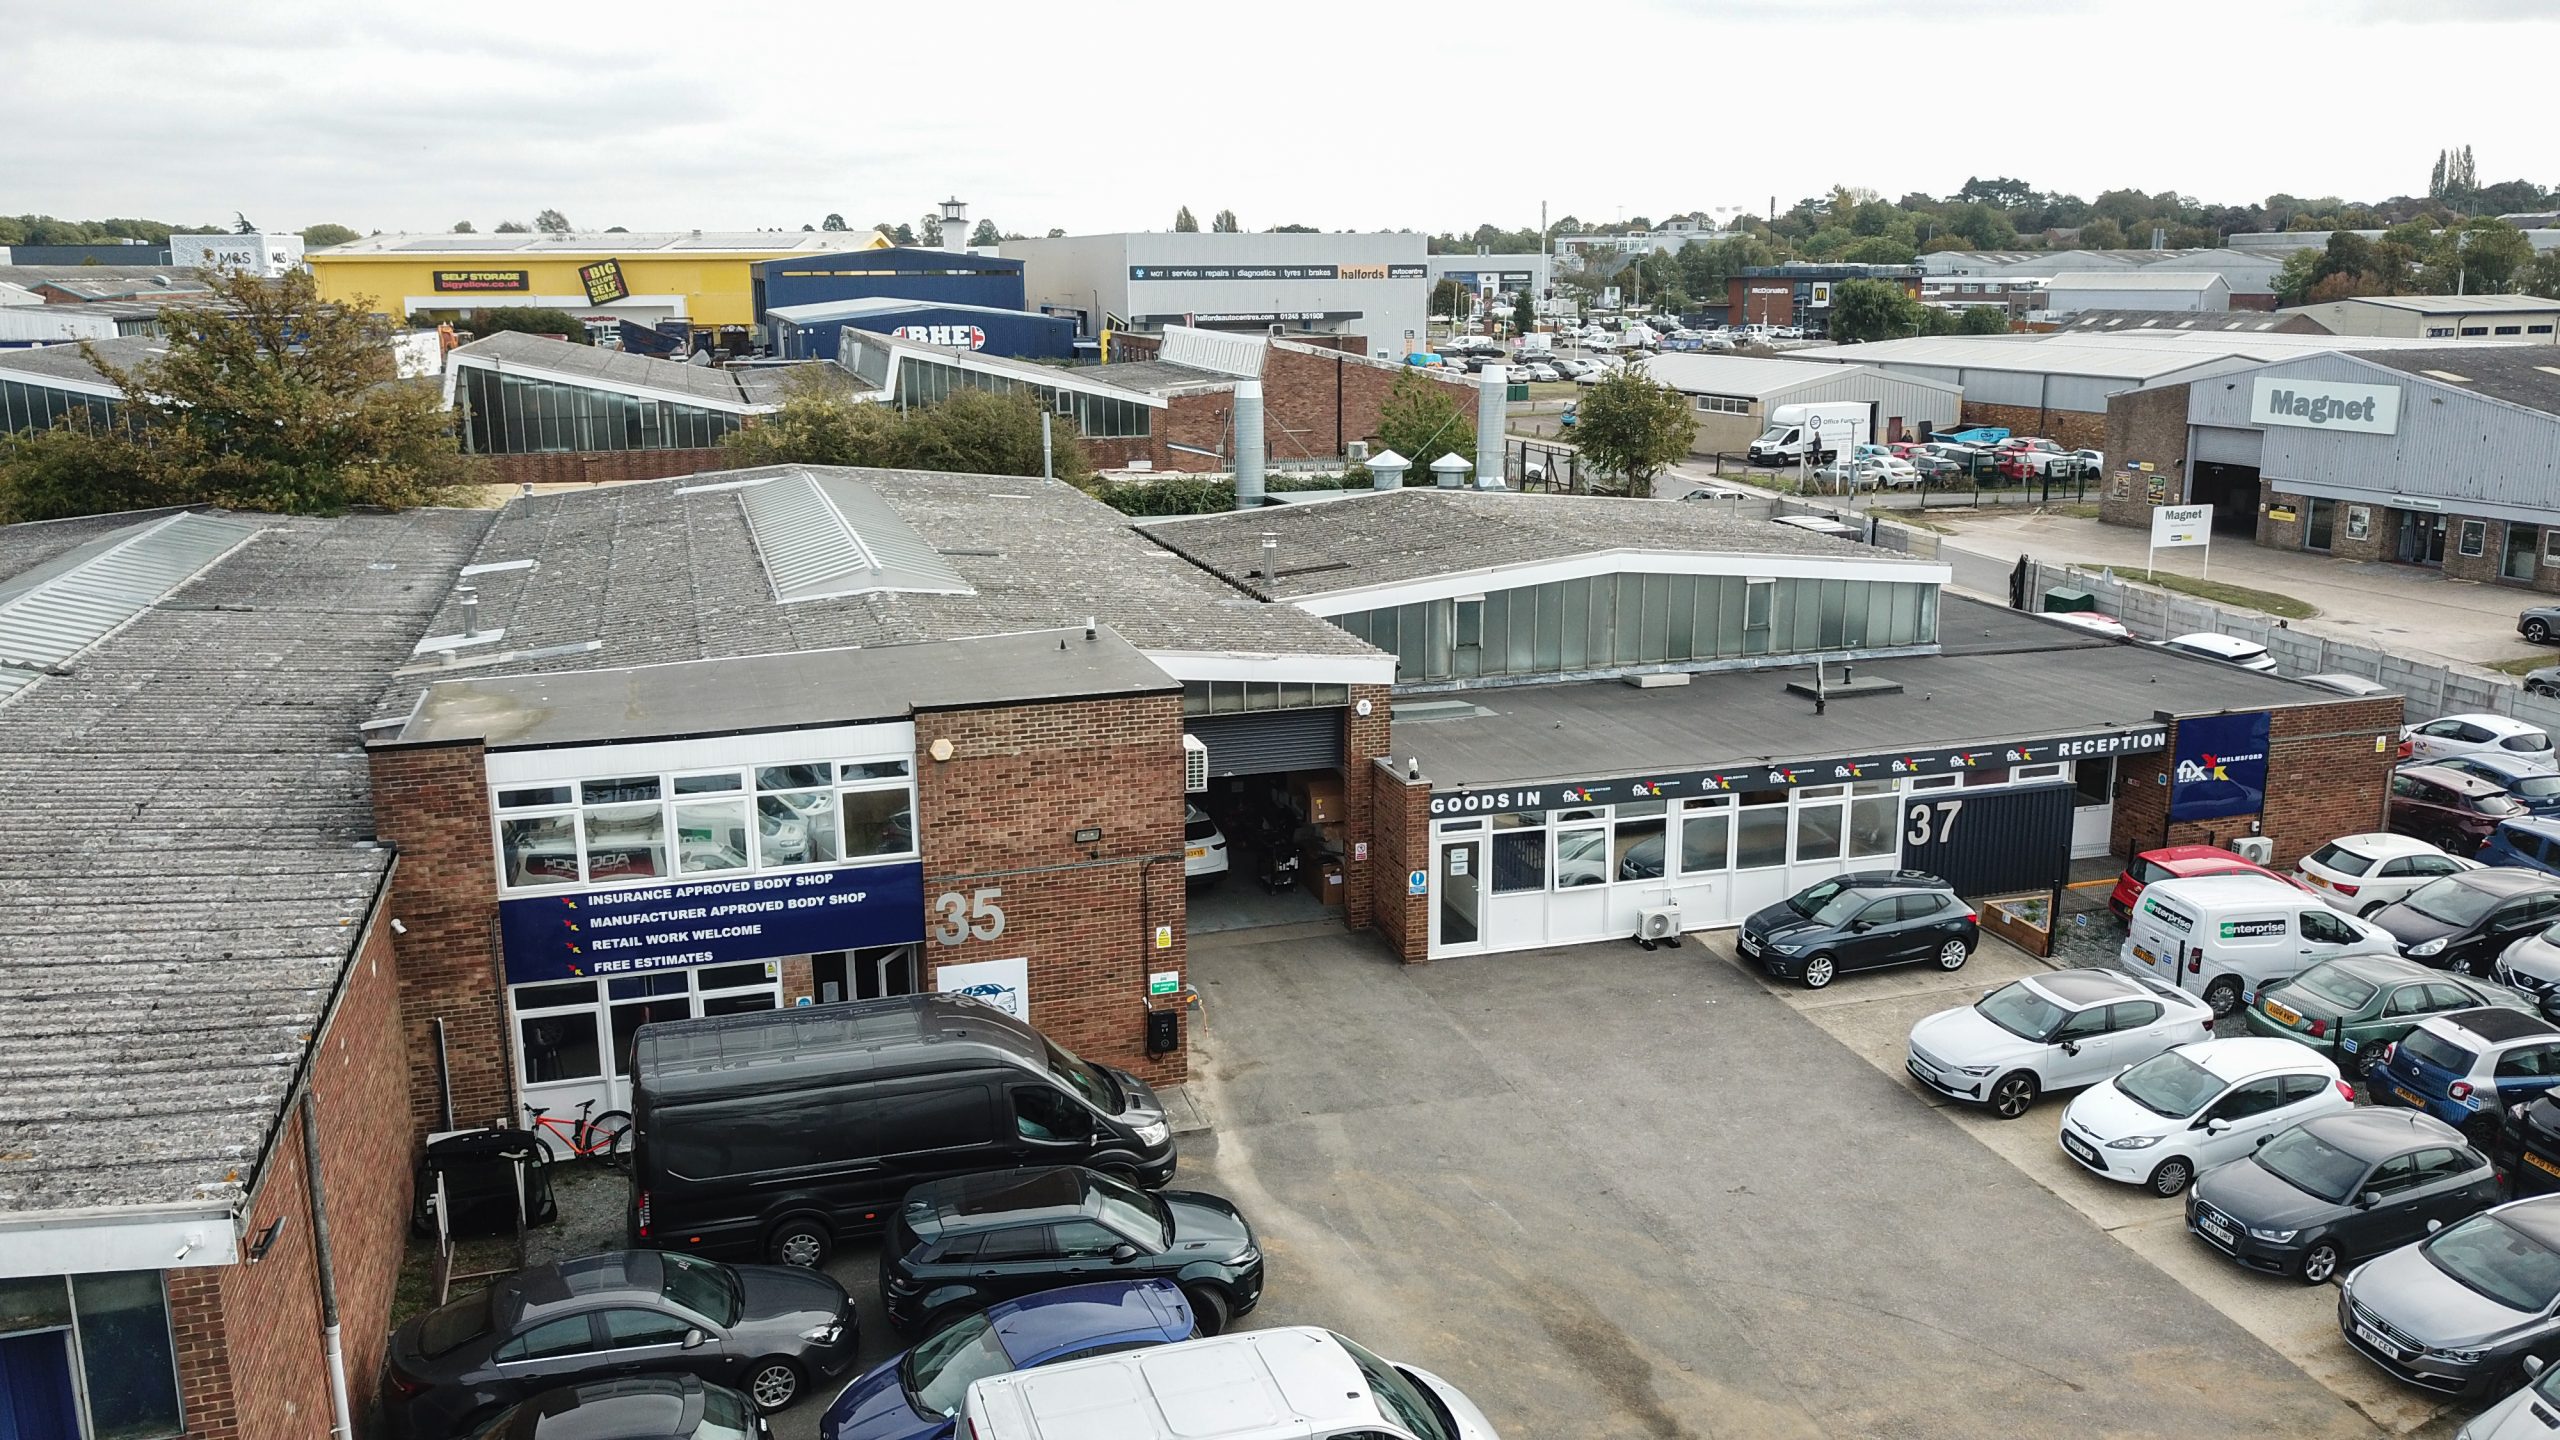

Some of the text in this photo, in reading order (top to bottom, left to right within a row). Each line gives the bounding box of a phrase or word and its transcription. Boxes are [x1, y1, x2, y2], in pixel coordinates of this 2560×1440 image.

[220, 252, 251, 264] M&S
[272, 252, 287, 263] M&S
[442, 273, 520, 281] SELF STORAGE
[589, 262, 616, 279] BIG
[1172, 269, 1198, 277] service
[1205, 269, 1229, 278] repairs
[1237, 269, 1276, 278] diagnostics
[1284, 269, 1301, 278] tyres
[1308, 268, 1331, 276] brakes
[1341, 269, 1384, 280] halfords
[587, 274, 614, 287] YELLOW
[591, 280, 616, 296] SELF
[594, 290, 620, 302] STORAGE
[907, 326, 970, 345] BHE
[2269, 389, 2376, 424] Magnet
[2165, 509, 2202, 522] Magnet
[2058, 733, 2166, 757] RECEPTION
[2216, 754, 2262, 763] CHELMSFORD
[1430, 791, 1540, 814] GOODS IN
[1907, 800, 1963, 846] 37
[588, 874, 834, 906] INSURANCE APPROVED BODY SHOP
[590, 892, 867, 928] MANUFACTURER APPROVED BODY SHOP
[936, 888, 1005, 946] 35
[2145, 902, 2192, 930] enterprise
[592, 924, 762, 950] RETAIL WORK WELCOME
[2222, 922, 2285, 934] enterprise
[594, 952, 714, 974] FREE ESTIMATES
[2361, 1328, 2394, 1356] YB17 CEN
